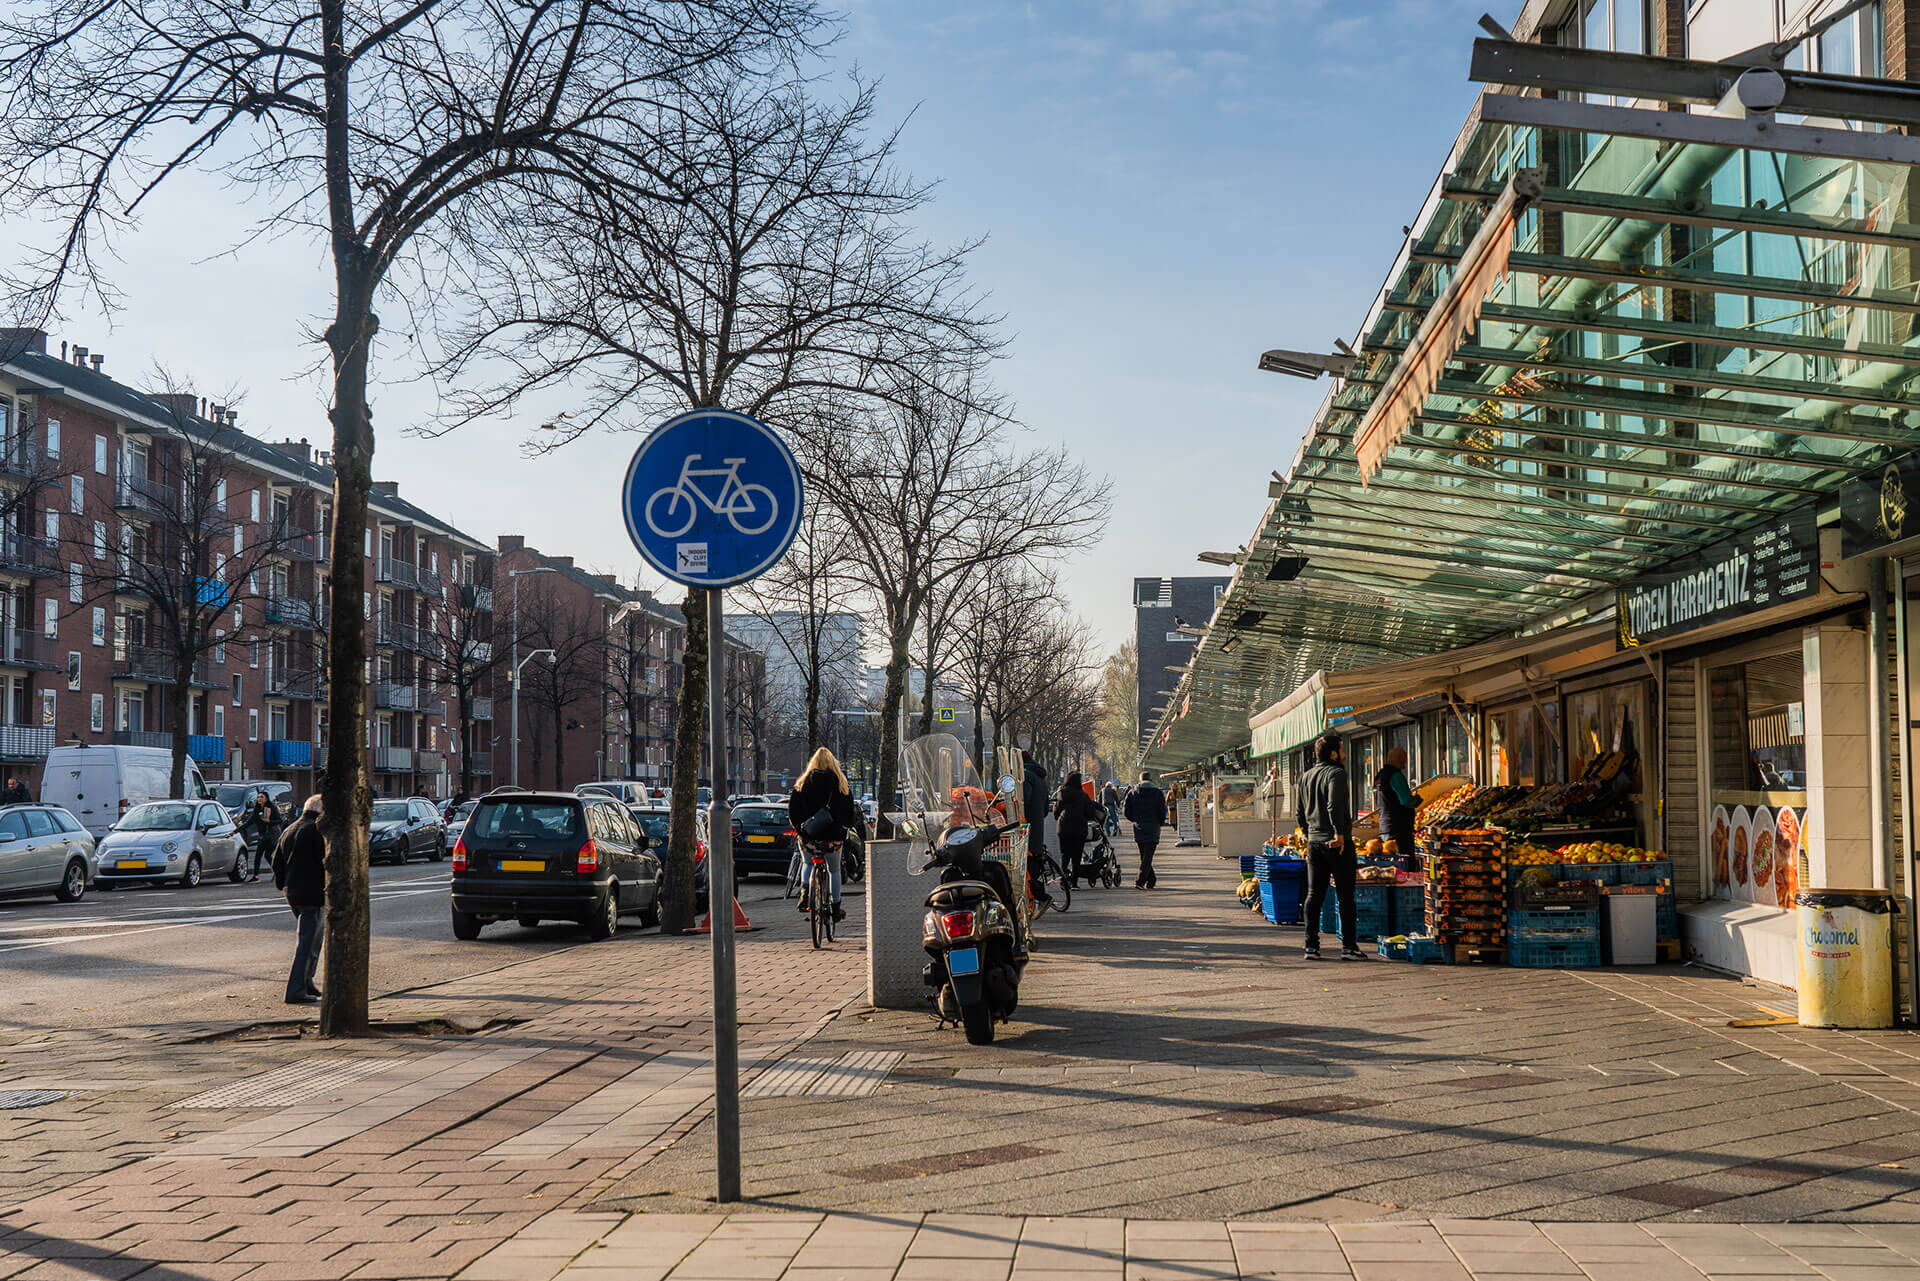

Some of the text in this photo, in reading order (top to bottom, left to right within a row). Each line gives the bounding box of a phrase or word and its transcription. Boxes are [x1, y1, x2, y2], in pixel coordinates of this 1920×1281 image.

[1628, 547, 1750, 638] YÖREM KARADENİZ
[1806, 927, 1860, 947] Chocomel
